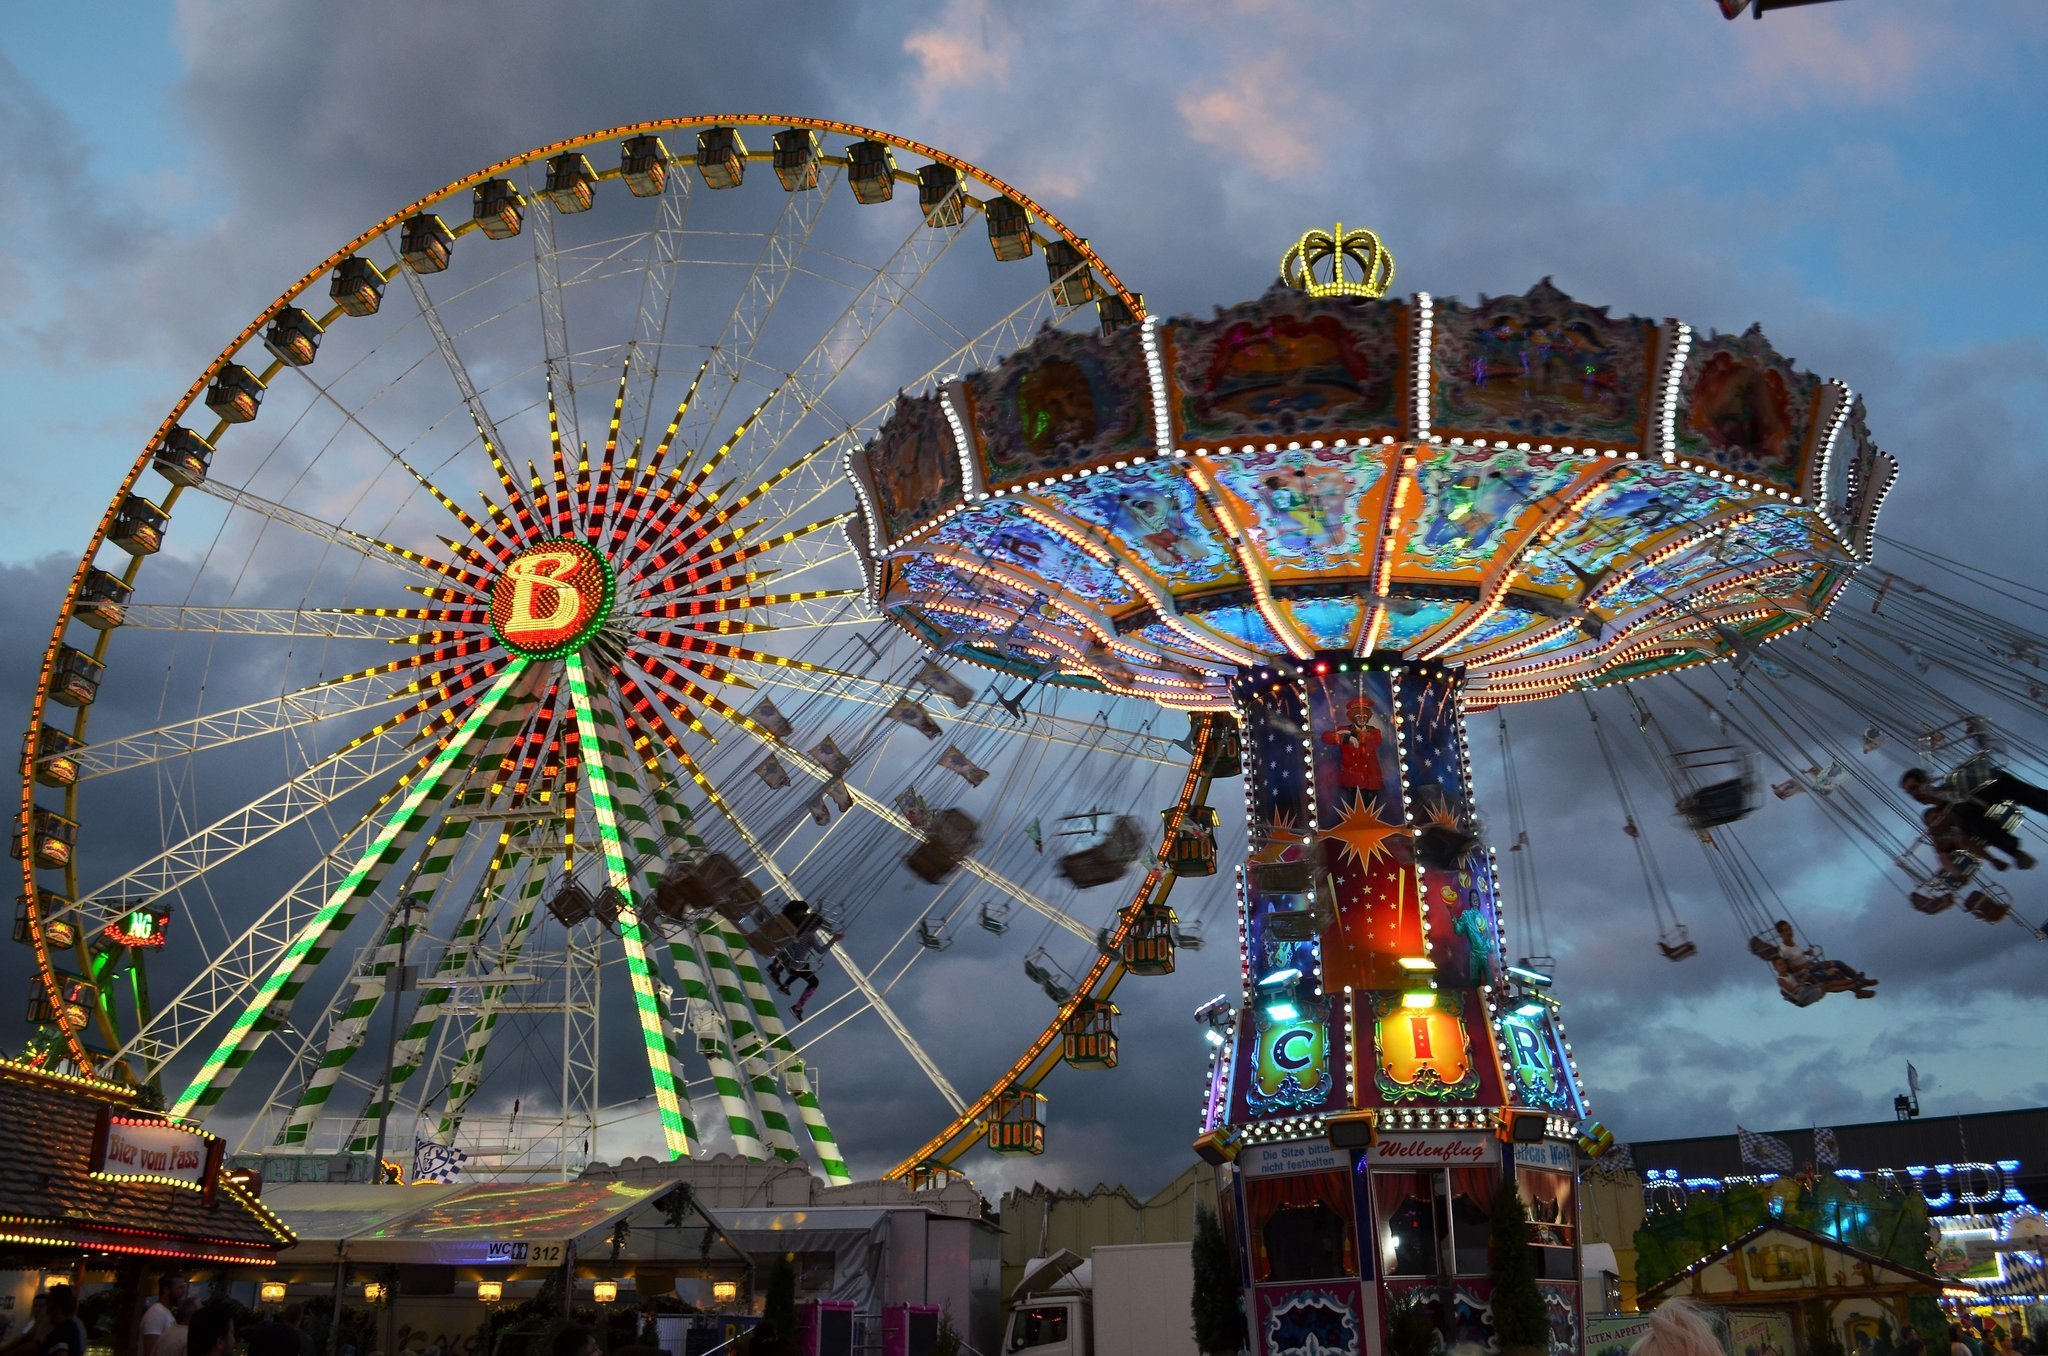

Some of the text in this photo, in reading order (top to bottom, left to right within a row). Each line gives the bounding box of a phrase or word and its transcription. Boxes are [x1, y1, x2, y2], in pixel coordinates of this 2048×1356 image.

[504, 551, 582, 636] B
[1273, 1017, 1546, 1069] C I R
[108, 1134, 200, 1171] Bier vom Fass
[1262, 1144, 1330, 1160] Die Sitze bitte
[1377, 1140, 1485, 1161] Wellenflug
[1261, 1157, 1335, 1173] nicht festhalten
[489, 1242, 511, 1255] WC
[532, 1246, 560, 1260] 312
